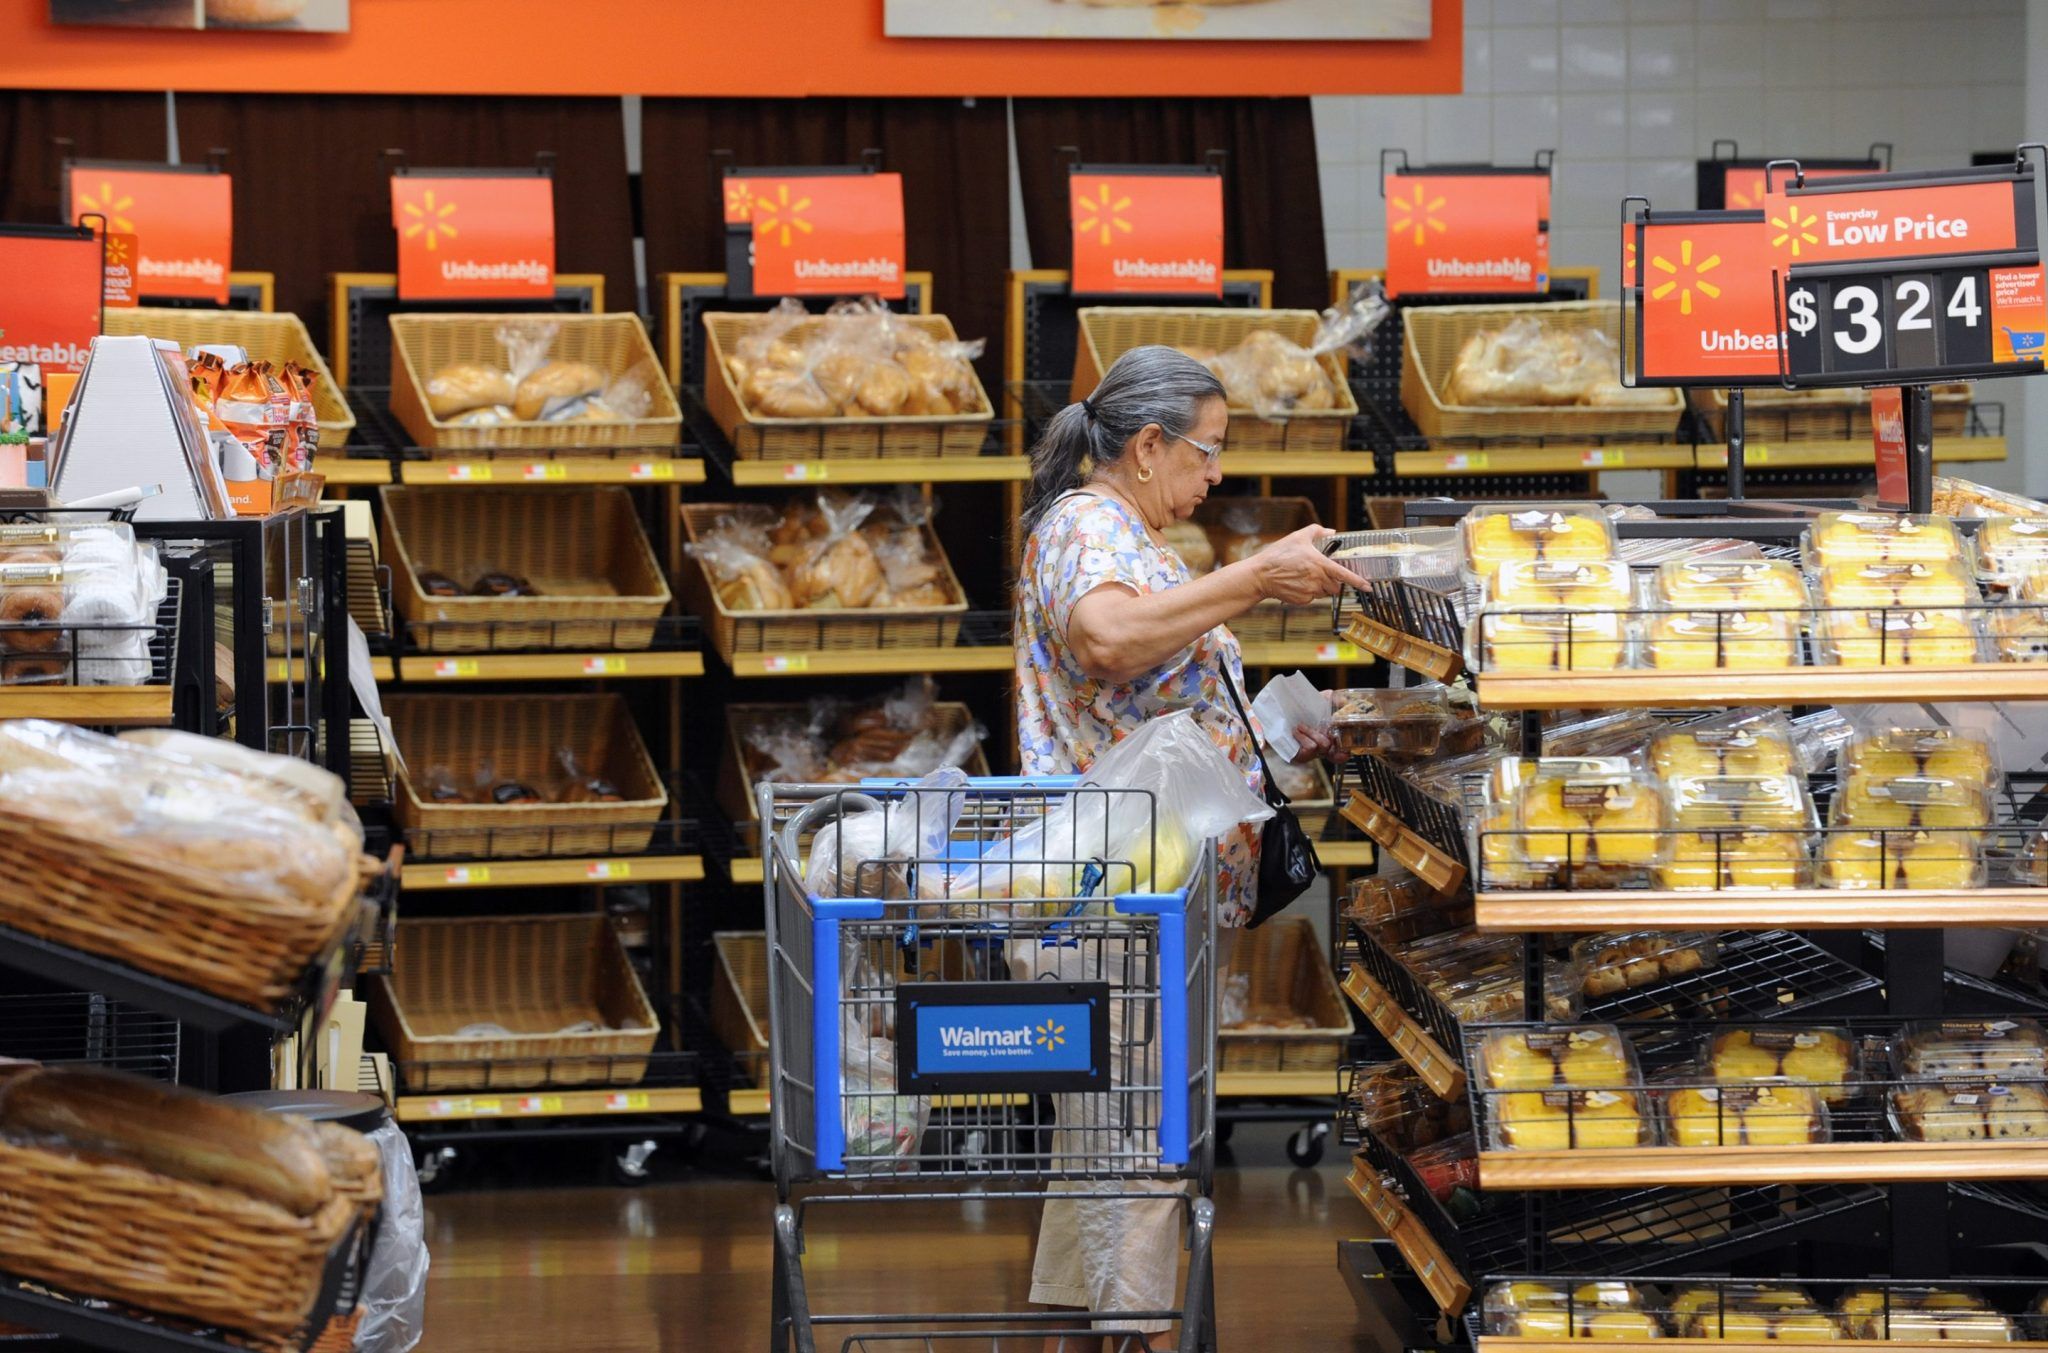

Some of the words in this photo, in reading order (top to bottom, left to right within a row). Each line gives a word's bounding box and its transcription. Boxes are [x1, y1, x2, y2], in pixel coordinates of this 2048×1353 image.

[1826, 208, 1879, 222] Everyday
[1827, 222, 1889, 247] Low
[1894, 213, 1968, 242] Price
[441, 259, 549, 280] Unbeatable
[794, 257, 898, 278] Unbeatable
[1113, 258, 1216, 278] Unbeatable
[1427, 258, 1532, 277] Unbeatable
[0, 342, 90, 365] eatable
[939, 1026, 1032, 1047] Walmart
[942, 1048, 961, 1057] Save
[962, 1048, 990, 1058] money.
[990, 1048, 1007, 1056] Live
[1007, 1047, 1034, 1056] better.
